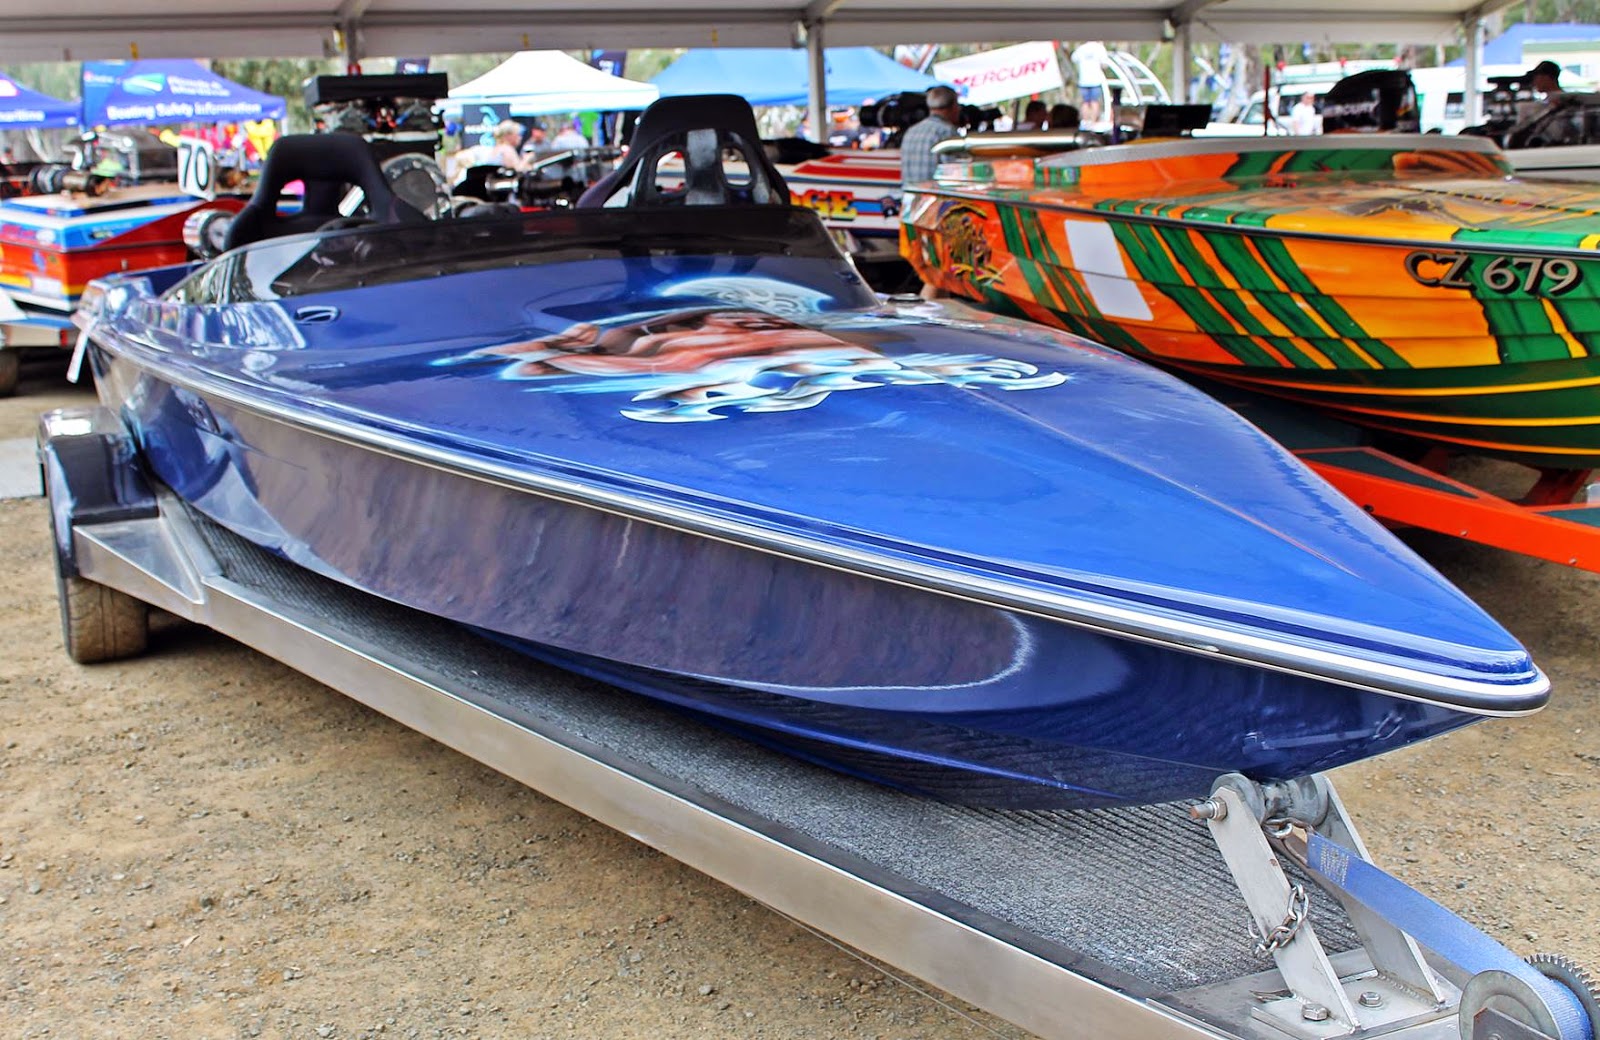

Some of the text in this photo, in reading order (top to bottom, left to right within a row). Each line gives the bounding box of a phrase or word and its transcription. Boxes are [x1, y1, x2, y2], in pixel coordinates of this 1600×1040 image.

[953, 58, 1050, 88] MERCURY
[106, 105, 155, 120] Boating
[155, 102, 193, 118] Safety
[180, 142, 210, 191] 70
[1404, 251, 1582, 296] CZ 679
